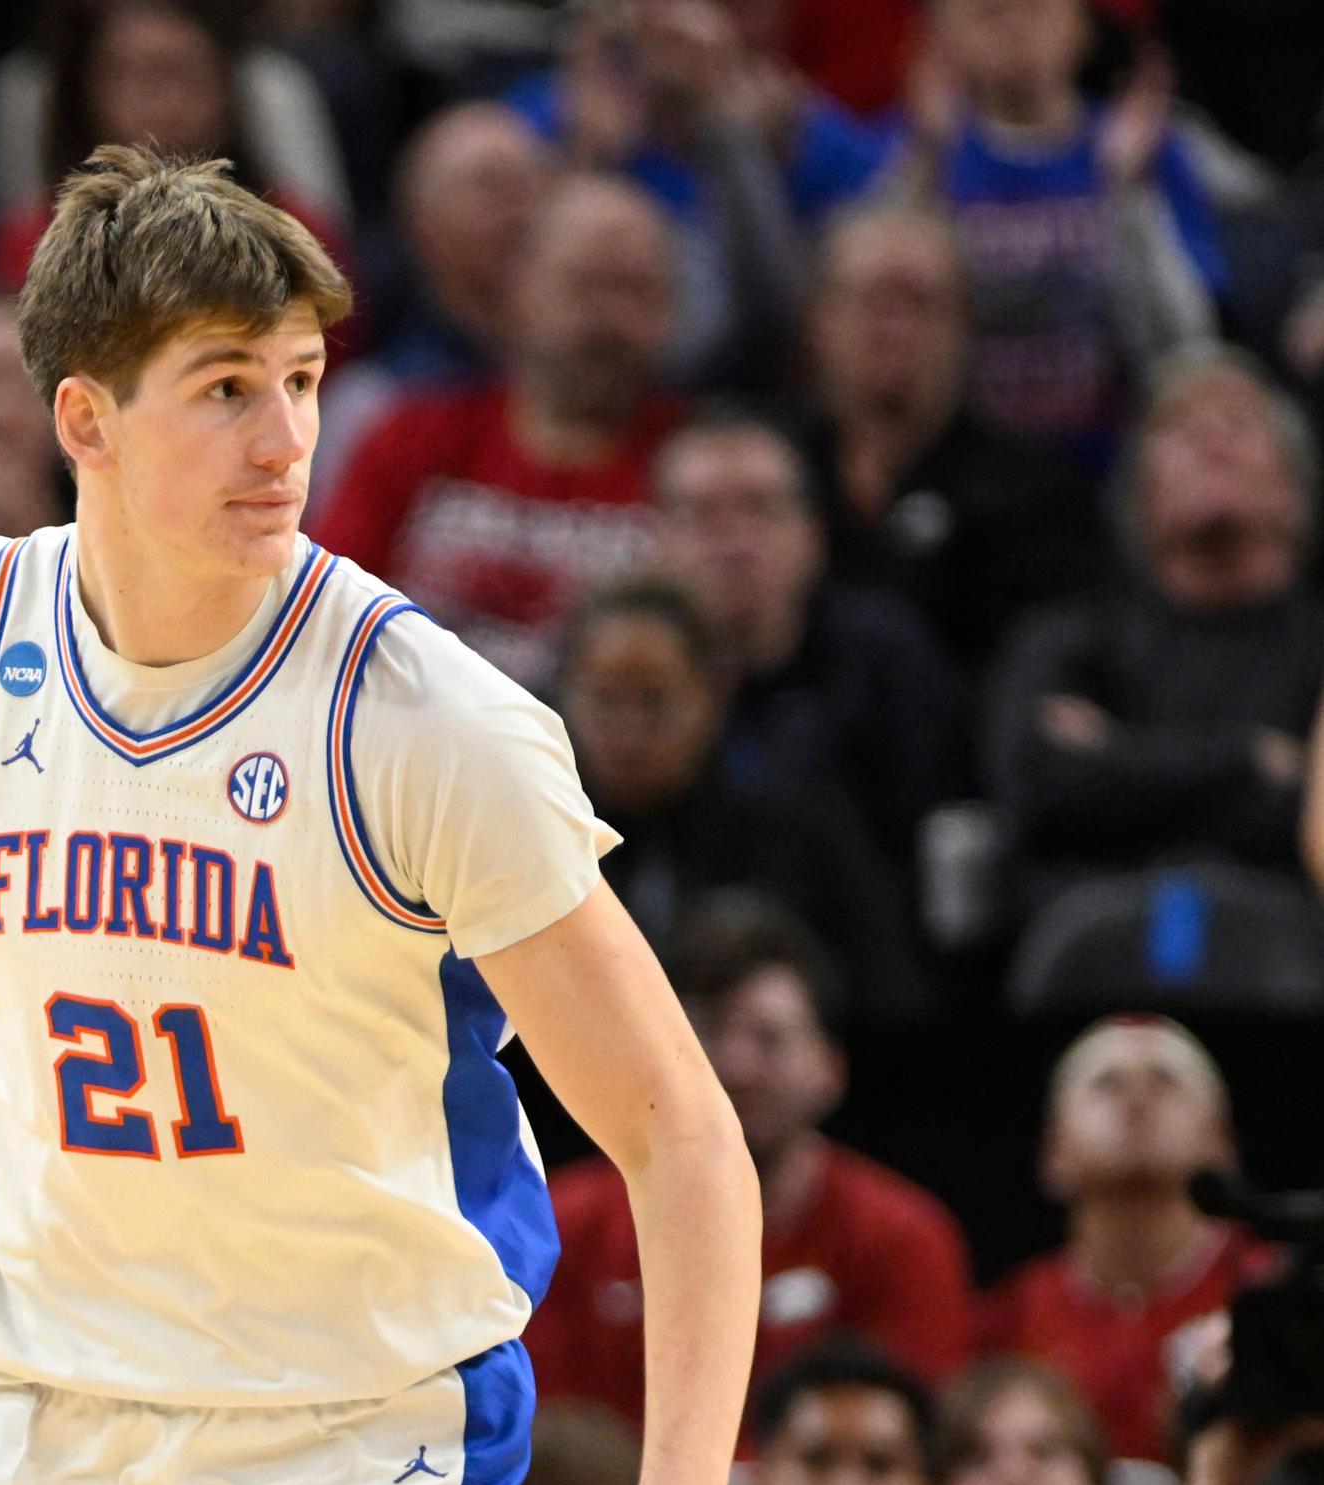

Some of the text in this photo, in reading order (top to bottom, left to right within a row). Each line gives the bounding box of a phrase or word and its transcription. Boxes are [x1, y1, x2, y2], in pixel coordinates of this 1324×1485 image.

[3, 666, 43, 682] NCAA
[232, 756, 285, 819] SEC
[44, 990, 246, 1162] 21
